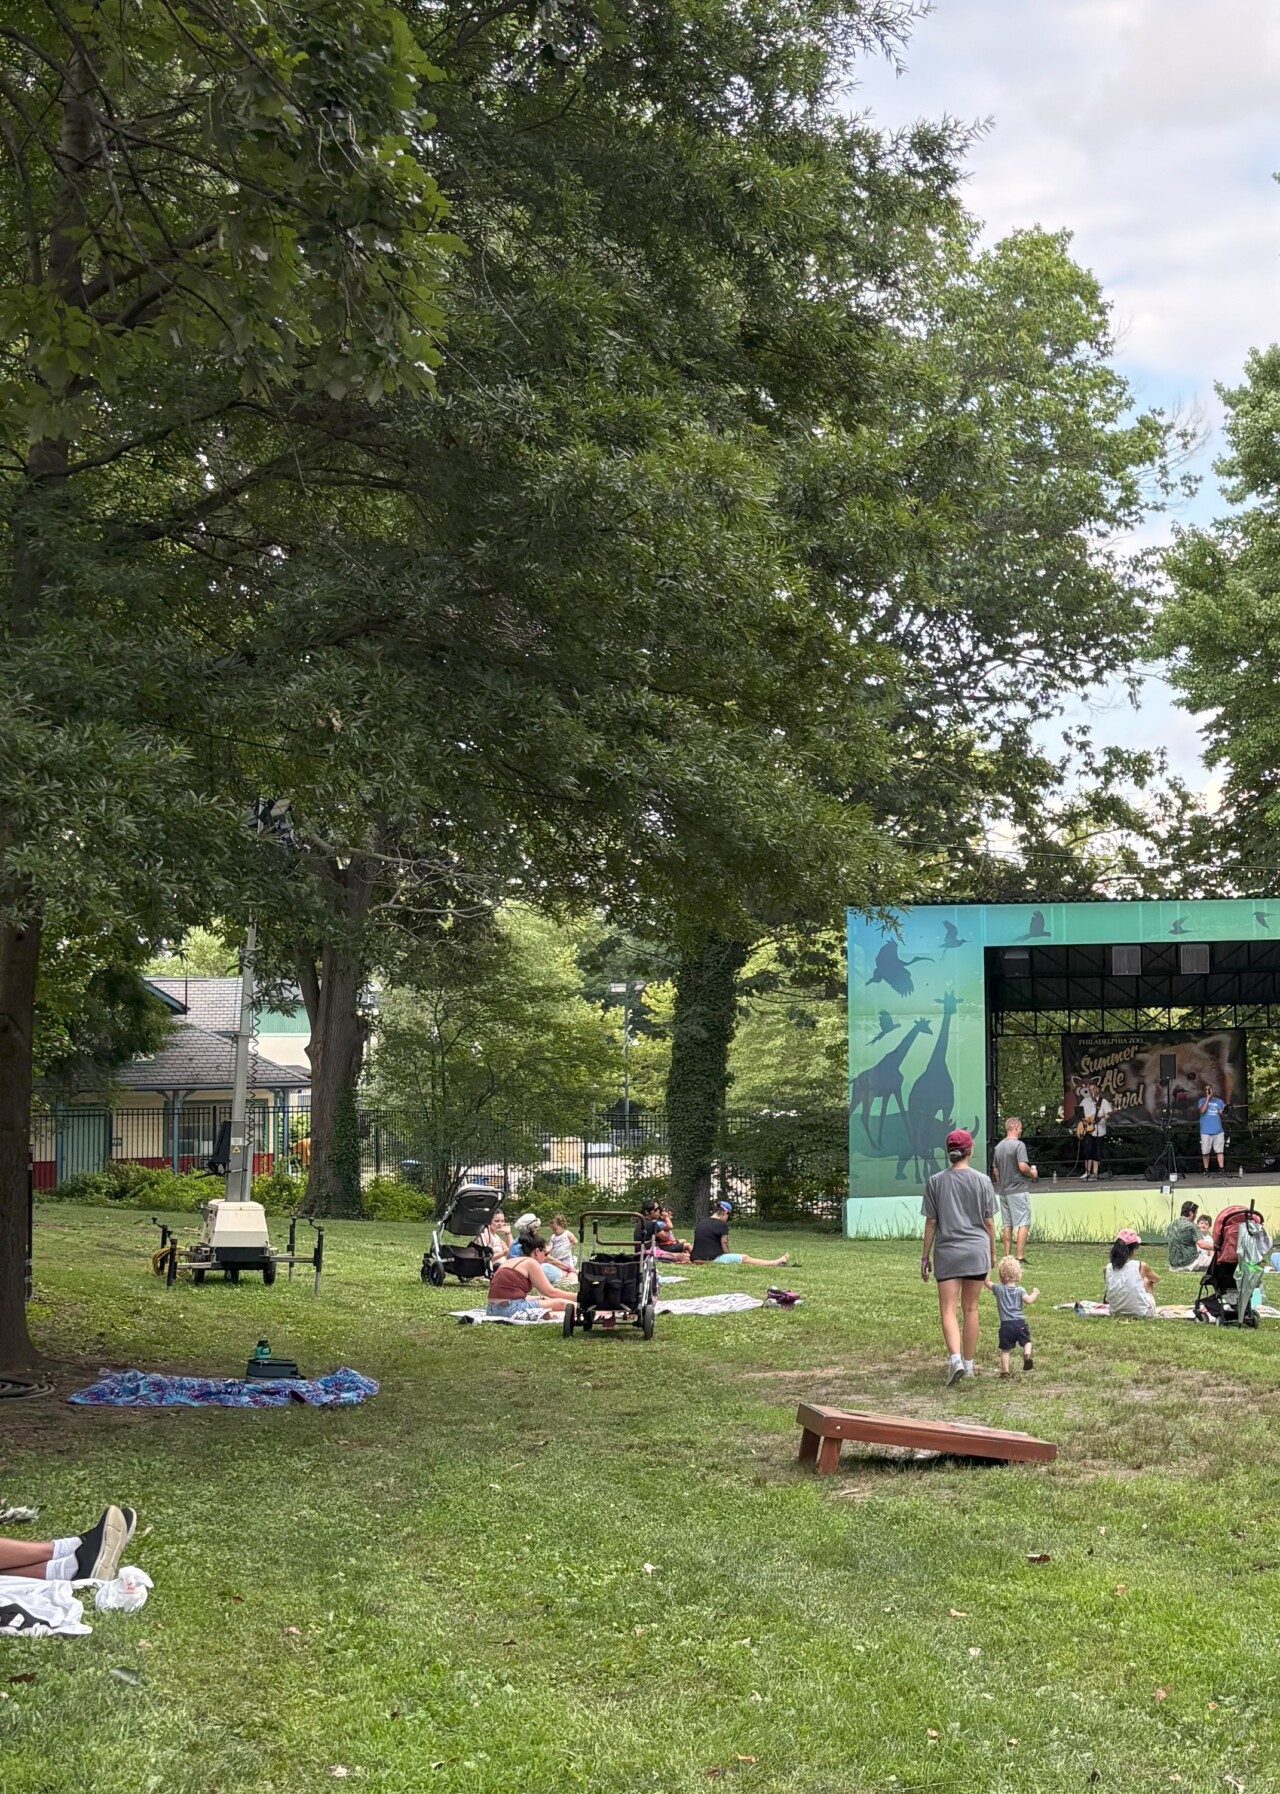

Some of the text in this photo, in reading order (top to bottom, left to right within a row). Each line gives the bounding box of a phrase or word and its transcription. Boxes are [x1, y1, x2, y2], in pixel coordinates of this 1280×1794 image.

[1080, 1045, 1139, 1075] Summer
[1101, 1068, 1125, 1094] Ale
[1112, 1084, 1144, 1109] tival
